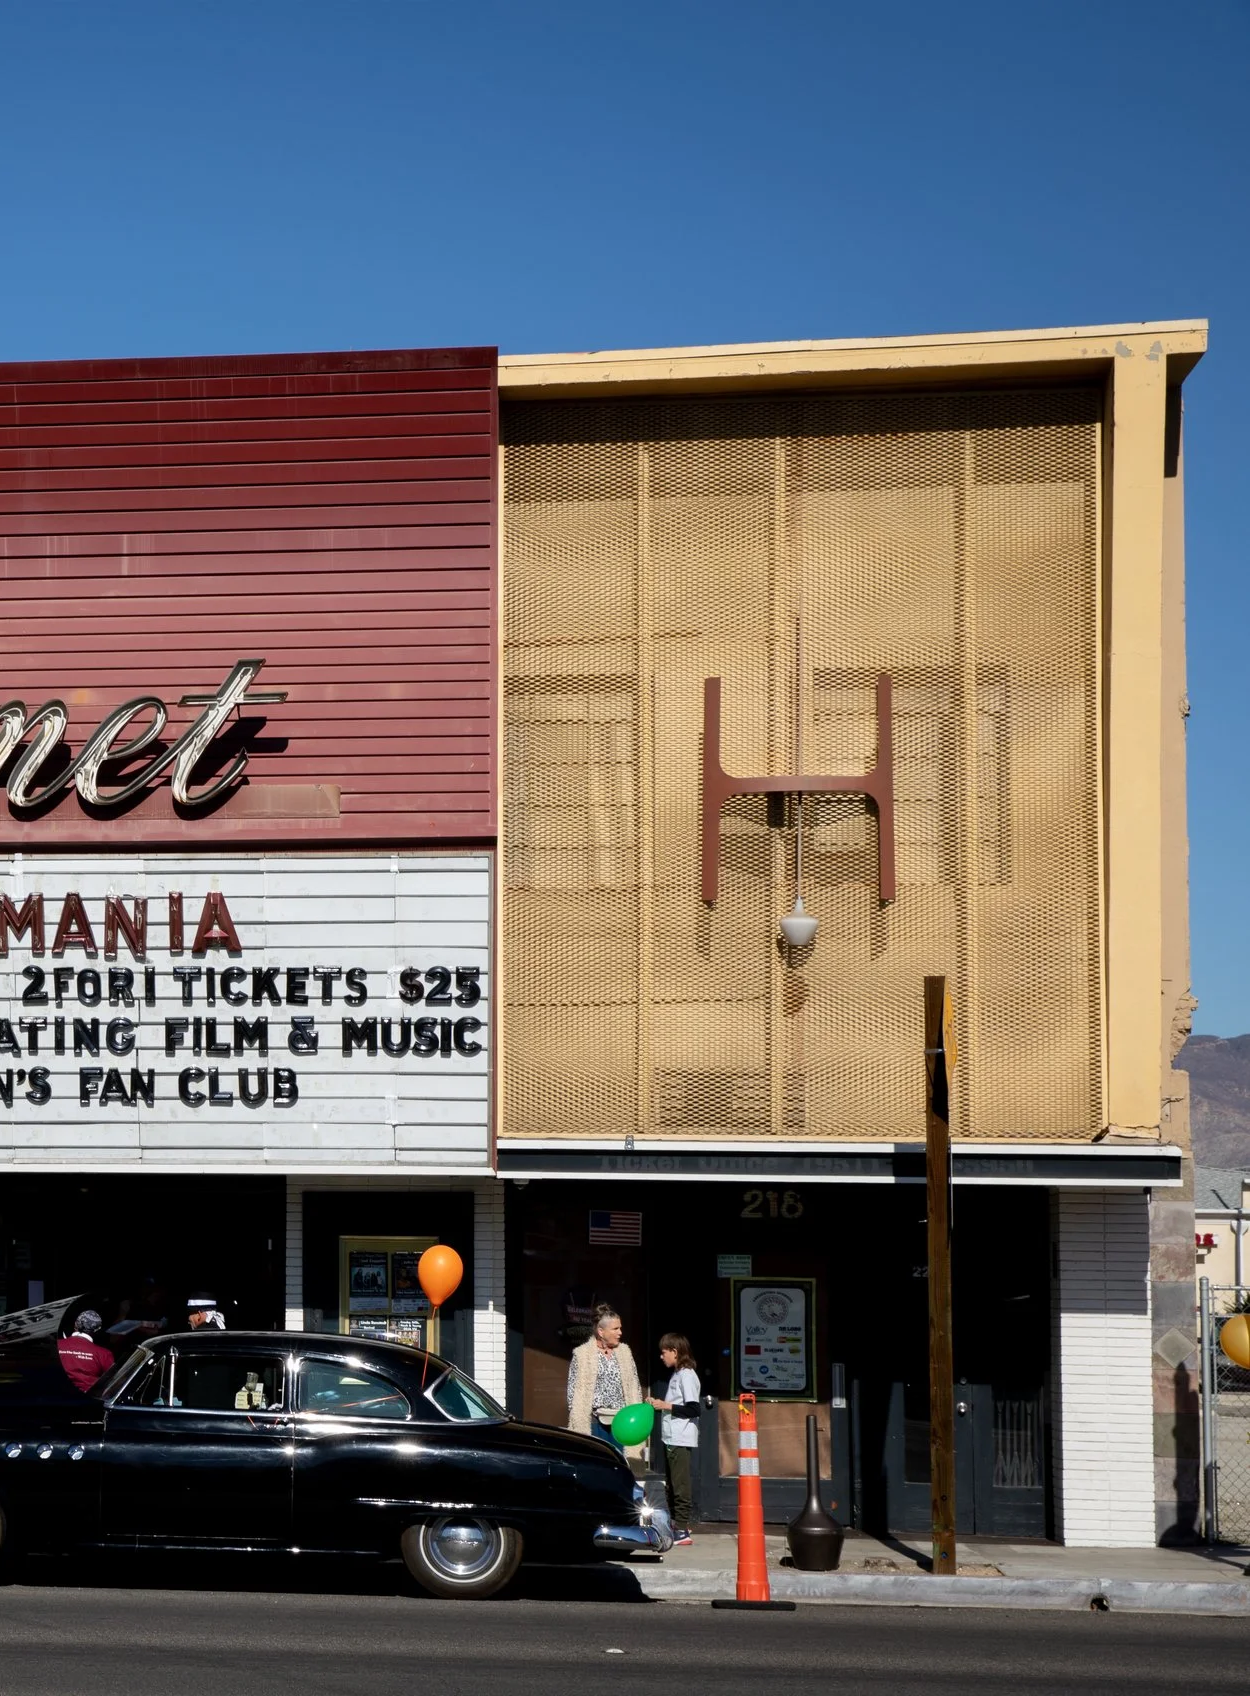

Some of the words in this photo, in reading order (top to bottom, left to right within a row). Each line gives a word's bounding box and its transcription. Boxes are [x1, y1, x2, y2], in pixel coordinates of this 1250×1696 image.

[172, 966, 368, 1007] TICKETS
[399, 966, 482, 1008] $25
[164, 1016, 269, 1057] FILM
[287, 1016, 319, 1056] &
[341, 1016, 483, 1057] MUSIC
[79, 1066, 156, 1107] FAN
[177, 1066, 300, 1108] CLUB
[740, 1187, 806, 1219] 218
